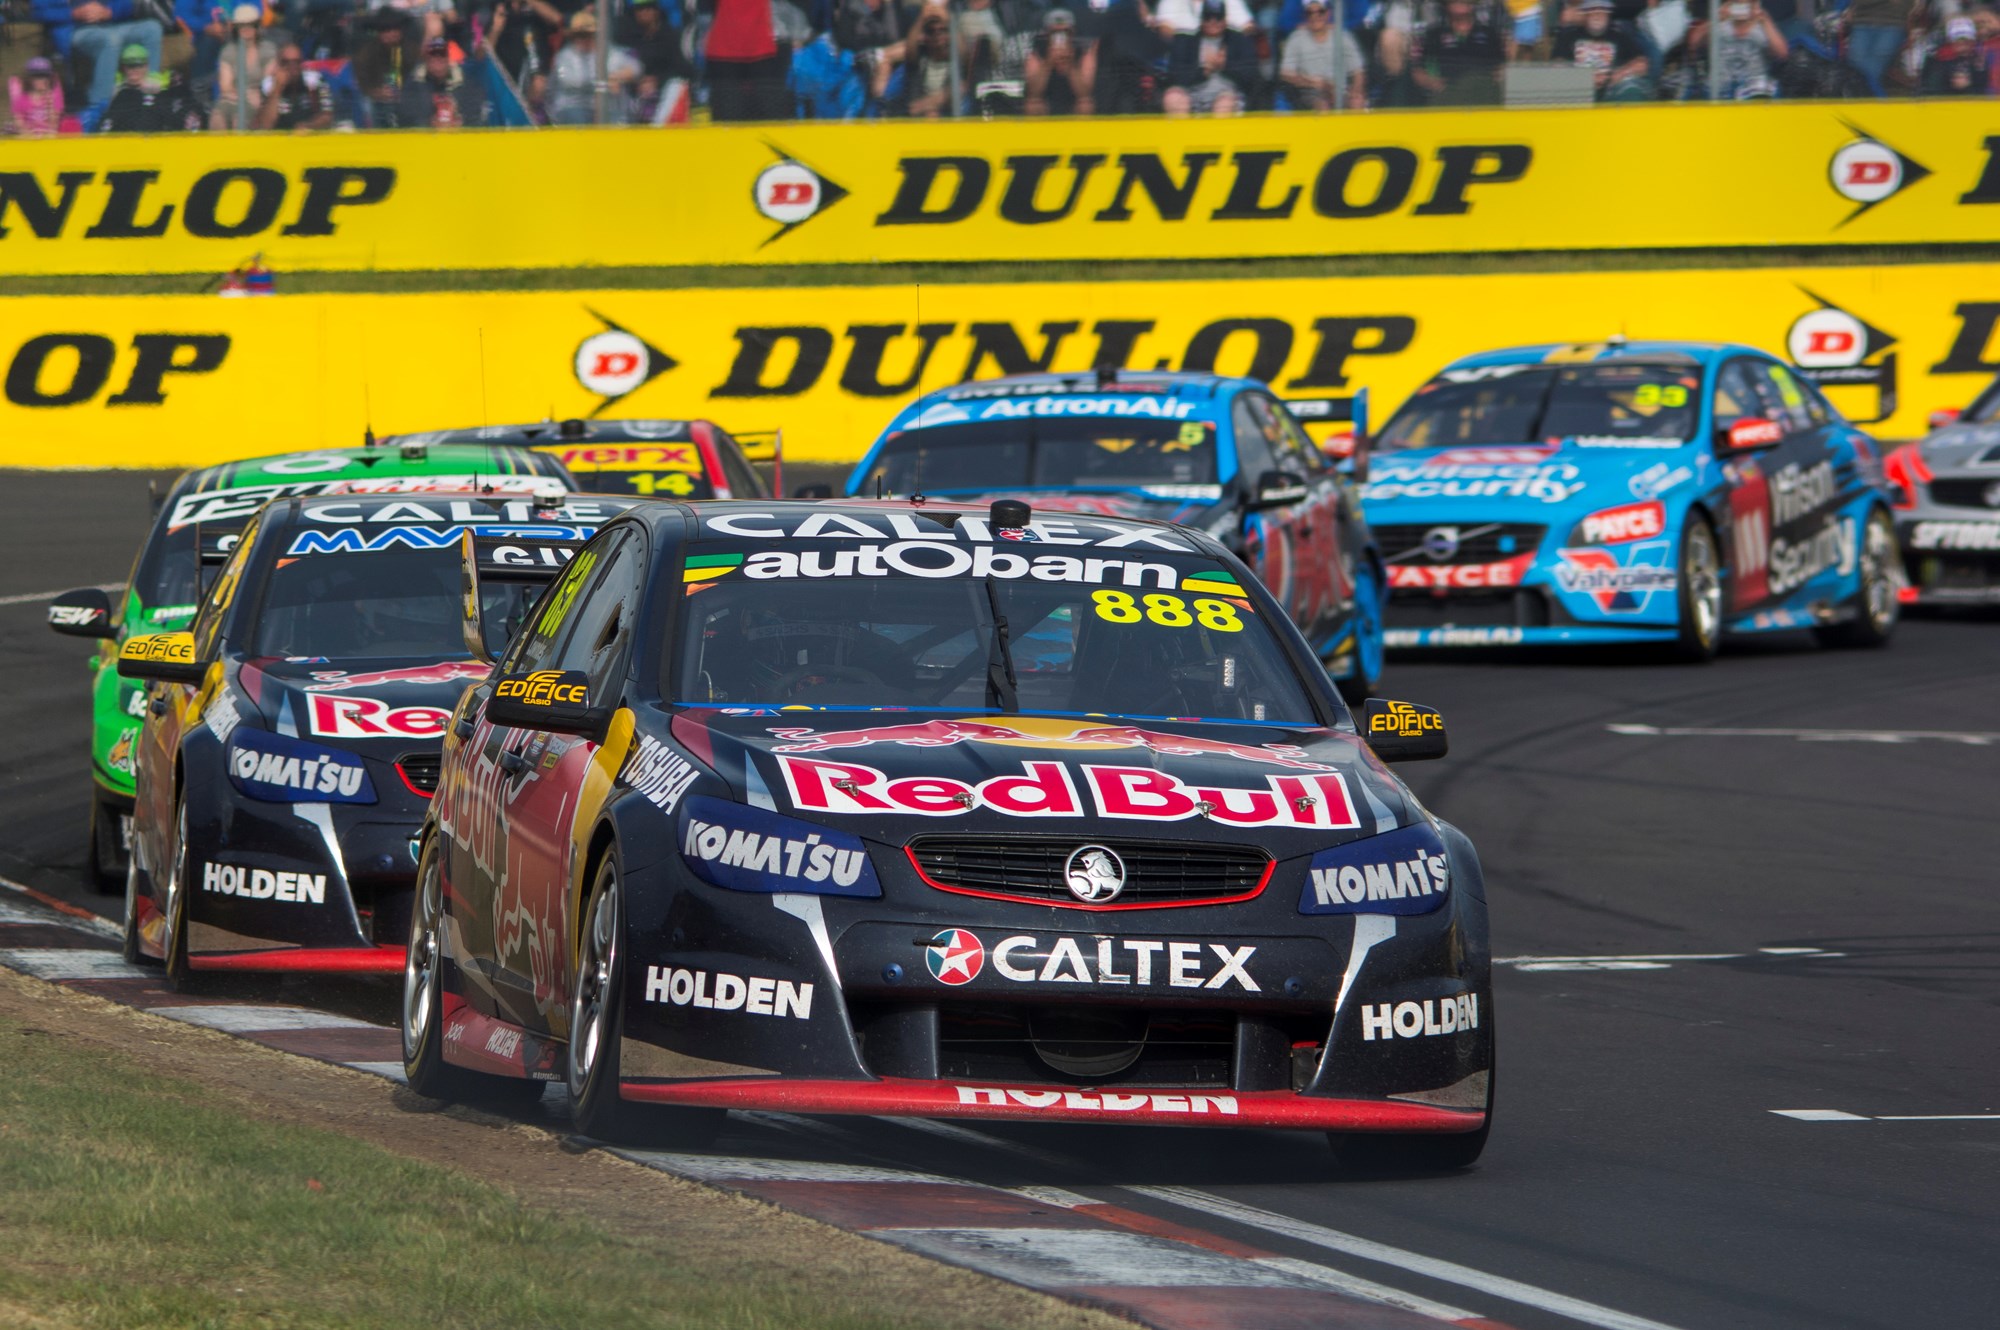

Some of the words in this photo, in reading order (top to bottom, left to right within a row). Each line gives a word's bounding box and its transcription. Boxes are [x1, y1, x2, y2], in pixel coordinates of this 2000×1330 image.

[874, 144, 1534, 225] DUNLOP
[4, 332, 232, 408] OP
[707, 315, 1417, 399] DUNLOP
[980, 397, 1195, 419] ActronAir
[1635, 384, 1687, 407] 33
[1178, 422, 1205, 445] 5
[627, 472, 694, 496] 14
[706, 513, 1195, 553] CALTEX
[1582, 509, 1661, 543] PAYCE
[1092, 590, 1244, 632] 888
[125, 642, 192, 657] EDIFICE
[496, 680, 587, 703] EDIFICE
[523, 697, 551, 705] CASIO
[1371, 713, 1444, 731] EDIFICE
[230, 746, 364, 797] KOMATSU
[619, 735, 700, 816] TOSHIBA
[775, 754, 1084, 817] Red
[1080, 764, 1361, 829] Bull
[685, 819, 865, 887] KOMATSU
[203, 862, 325, 904] HOLDEN
[1311, 848, 1448, 905] KOMATS
[993, 936, 1262, 992] CALTEX
[646, 966, 814, 1020] HOLDEN
[1361, 992, 1478, 1041] HOLDEN
